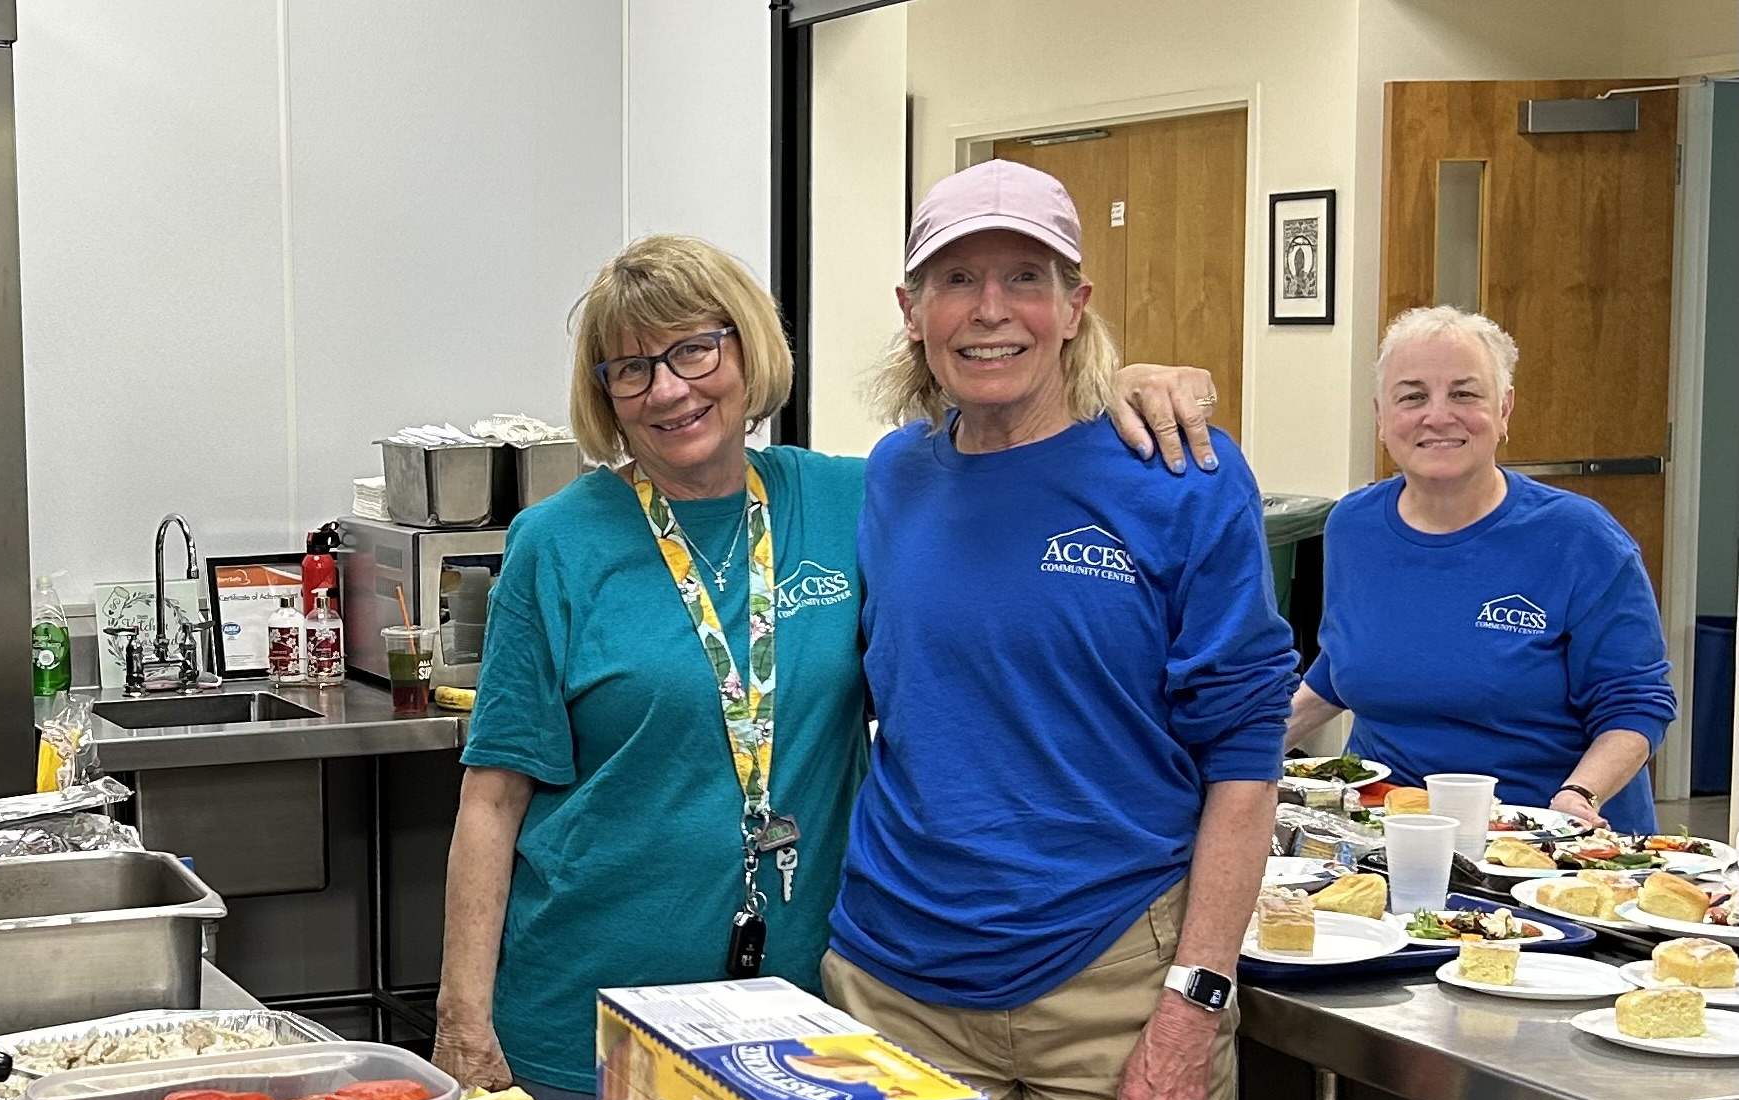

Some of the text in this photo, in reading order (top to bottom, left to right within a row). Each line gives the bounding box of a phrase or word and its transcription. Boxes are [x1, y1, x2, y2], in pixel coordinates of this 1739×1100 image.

[1040, 562, 1136, 585] COMMUNITY CENTER
[777, 572, 849, 608] ACCESS
[821, 590, 852, 606] CENTER
[1475, 620, 1518, 633] COMMUNITY
[1477, 604, 1547, 630] ACCESS
